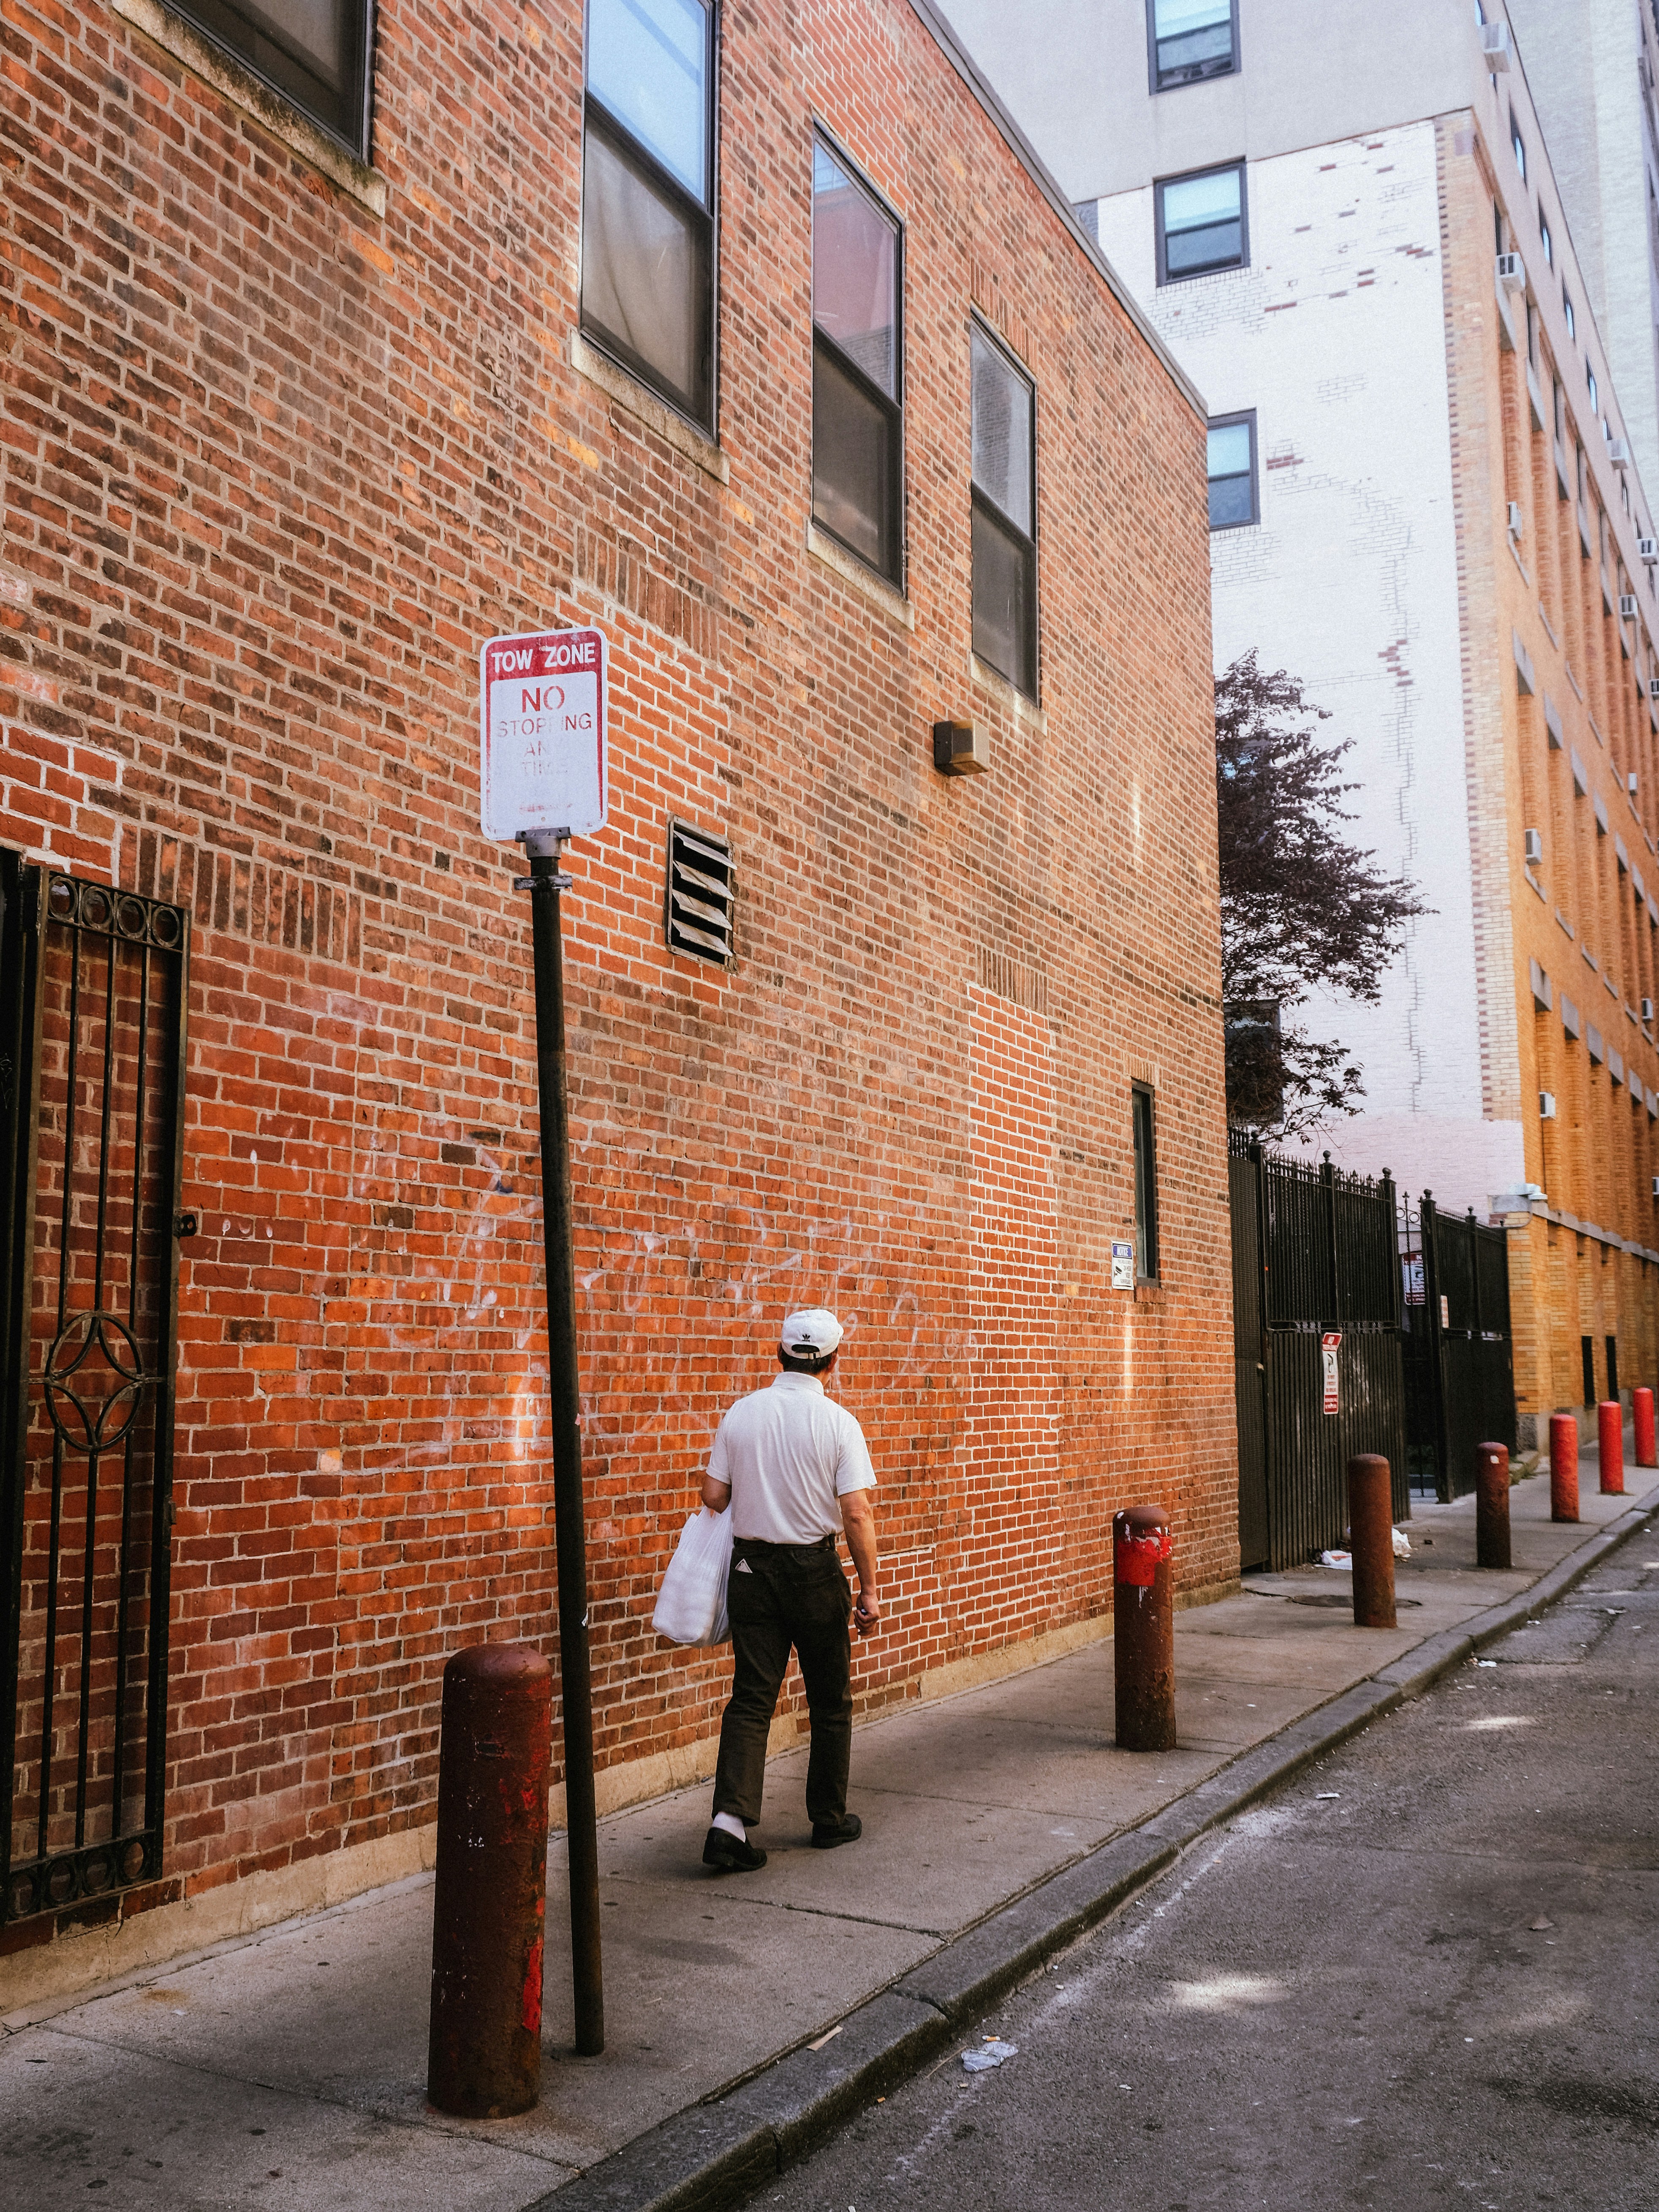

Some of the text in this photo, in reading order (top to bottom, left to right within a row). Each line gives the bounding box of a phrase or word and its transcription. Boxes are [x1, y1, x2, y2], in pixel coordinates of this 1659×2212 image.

[491, 642, 596, 673] TOW ZONE
[522, 685, 565, 713] NO
[497, 713, 592, 738] STOPING
[524, 740, 548, 756] AN
